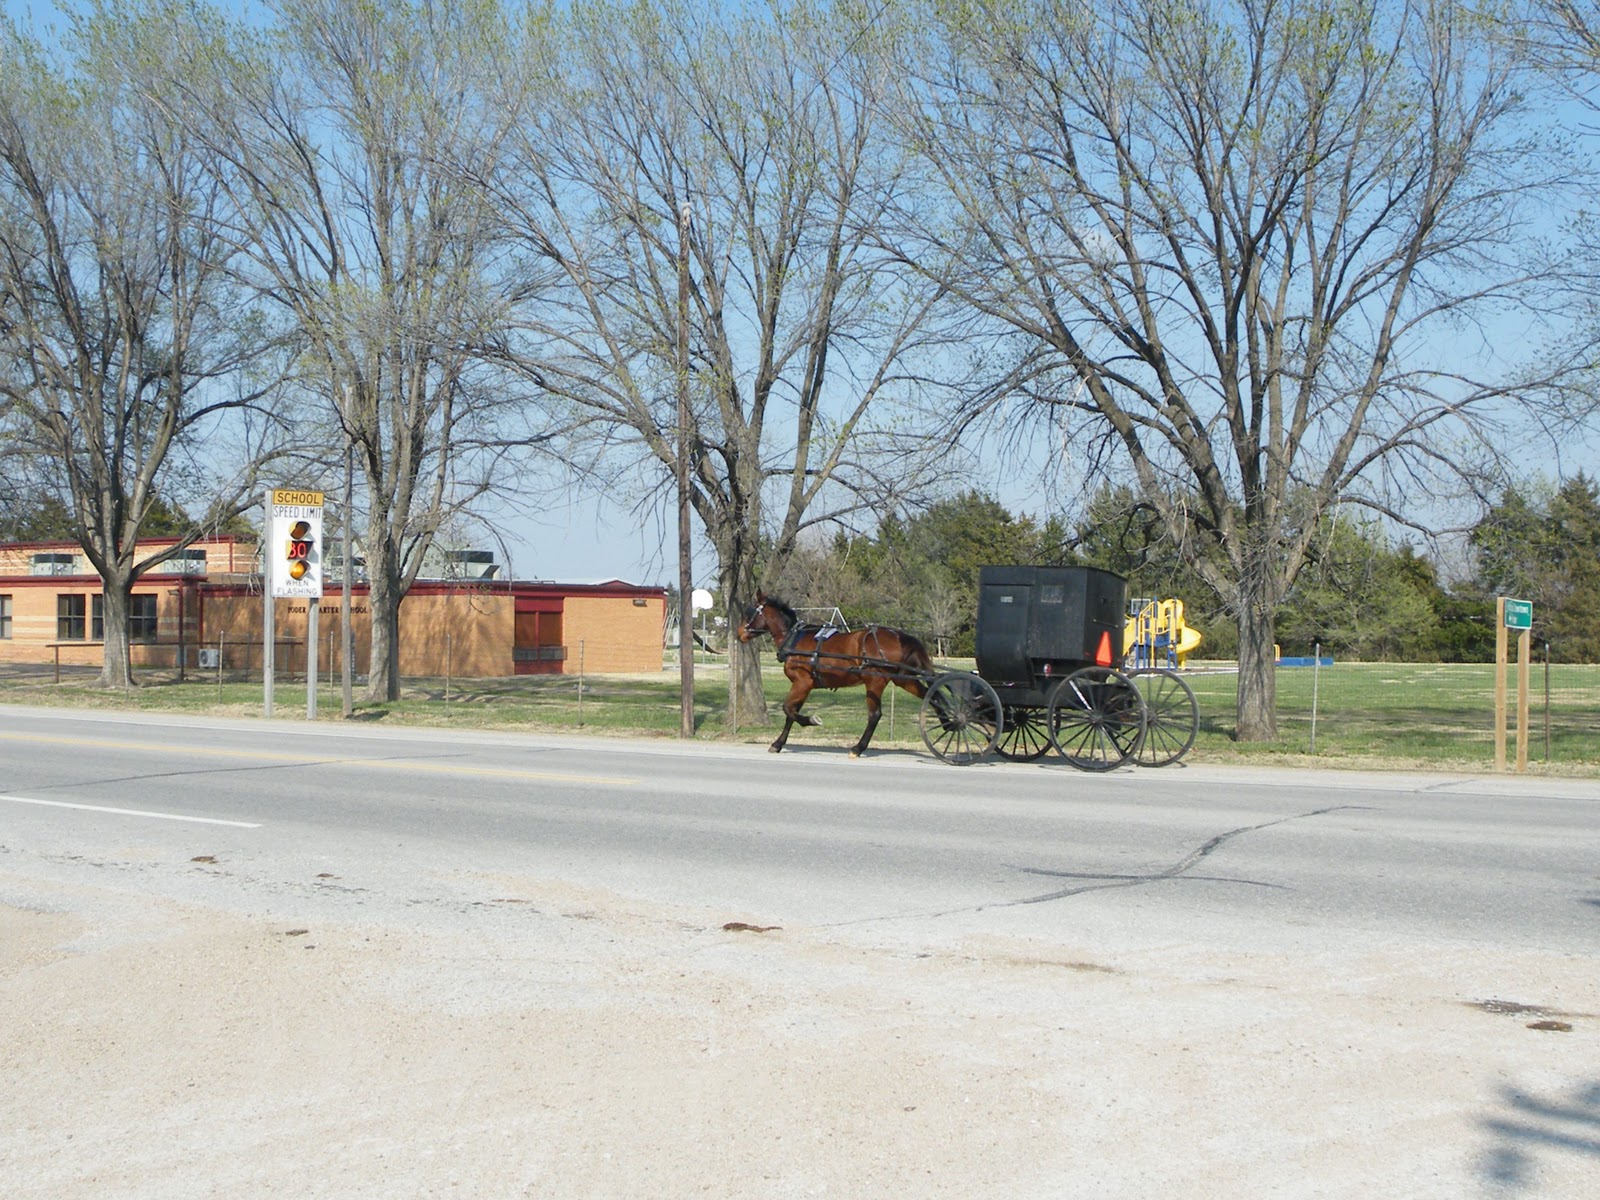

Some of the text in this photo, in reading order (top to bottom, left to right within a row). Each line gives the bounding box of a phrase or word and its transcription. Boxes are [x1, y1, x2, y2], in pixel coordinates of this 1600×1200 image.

[277, 492, 320, 505] SCHOOL
[274, 505, 322, 519] SPEED LIMIT
[285, 579, 309, 587] WHEN
[277, 587, 318, 595] FLASHING
